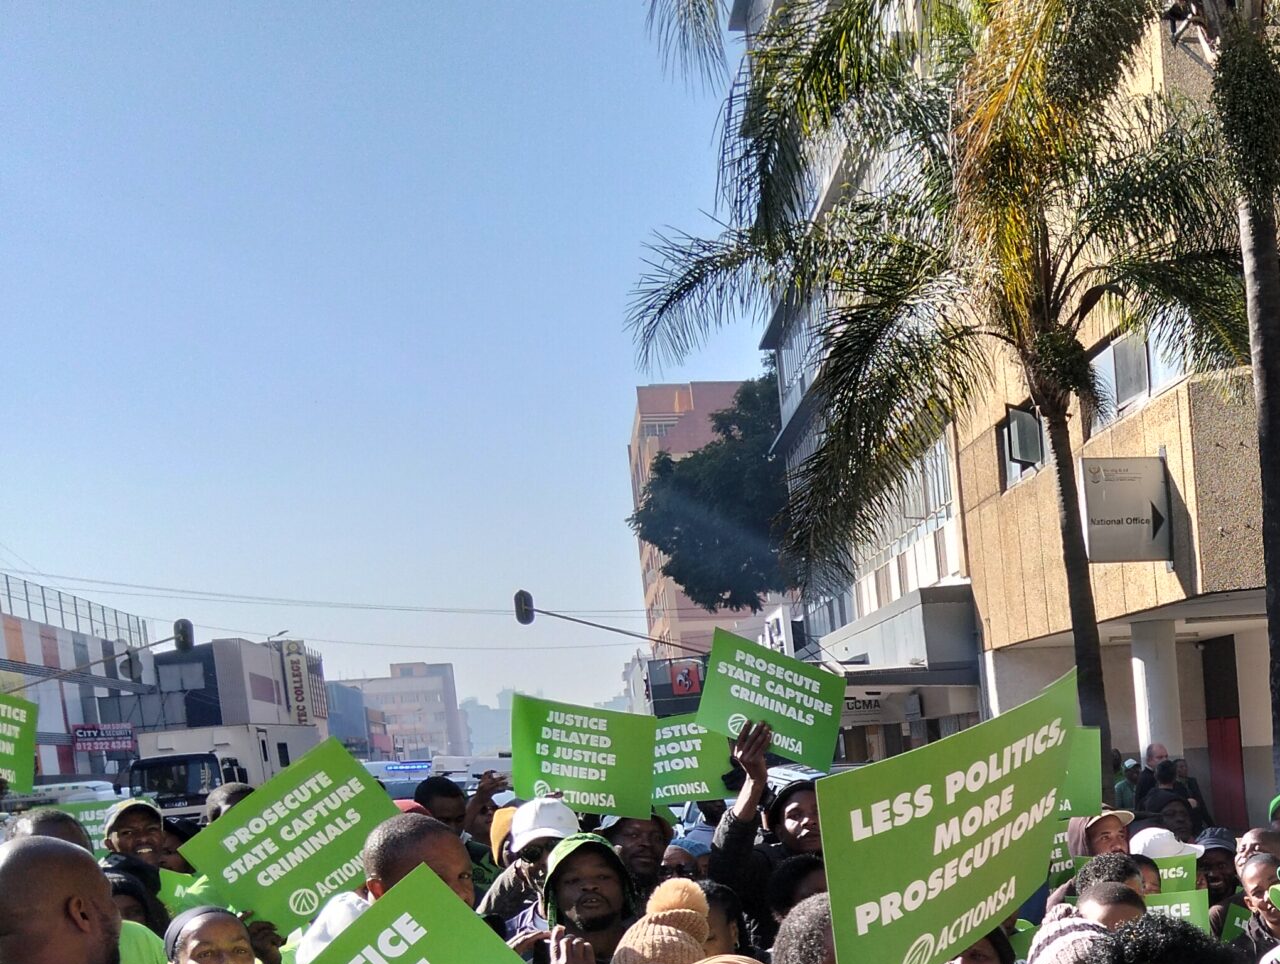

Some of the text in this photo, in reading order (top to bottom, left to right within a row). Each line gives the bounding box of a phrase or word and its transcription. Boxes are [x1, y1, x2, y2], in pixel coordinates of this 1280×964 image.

[1090, 517, 1150, 526] National Office
[291, 659, 305, 703] COLLEGE
[735, 650, 820, 693] PROSECUTE
[717, 661, 833, 716] STATE CAPTURE
[0, 704, 27, 722] TICE
[546, 711, 607, 731] JUSTICE
[730, 685, 815, 726] CRIMINALS
[76, 729, 98, 738] CITY
[541, 727, 612, 748] DELAYED
[655, 739, 702, 757] HOUT
[536, 743, 616, 766] IS JUSTICE
[655, 757, 699, 773] TION
[541, 761, 607, 781] DENIED!
[850, 717, 1067, 842] LESS POLITICS,
[656, 782, 709, 799] ACTIONSA
[223, 771, 333, 854] PROSECUTE
[933, 784, 1015, 856] MORE
[222, 777, 366, 884] STATE CAPTURE
[256, 808, 361, 887] CRIMINALS
[855, 788, 1058, 936] PROSECUTIONS
[315, 850, 366, 897] ACTION
[1159, 866, 1188, 880] TICS,
[934, 876, 1017, 957] ACTIONSA
[1146, 903, 1191, 917] STICE
